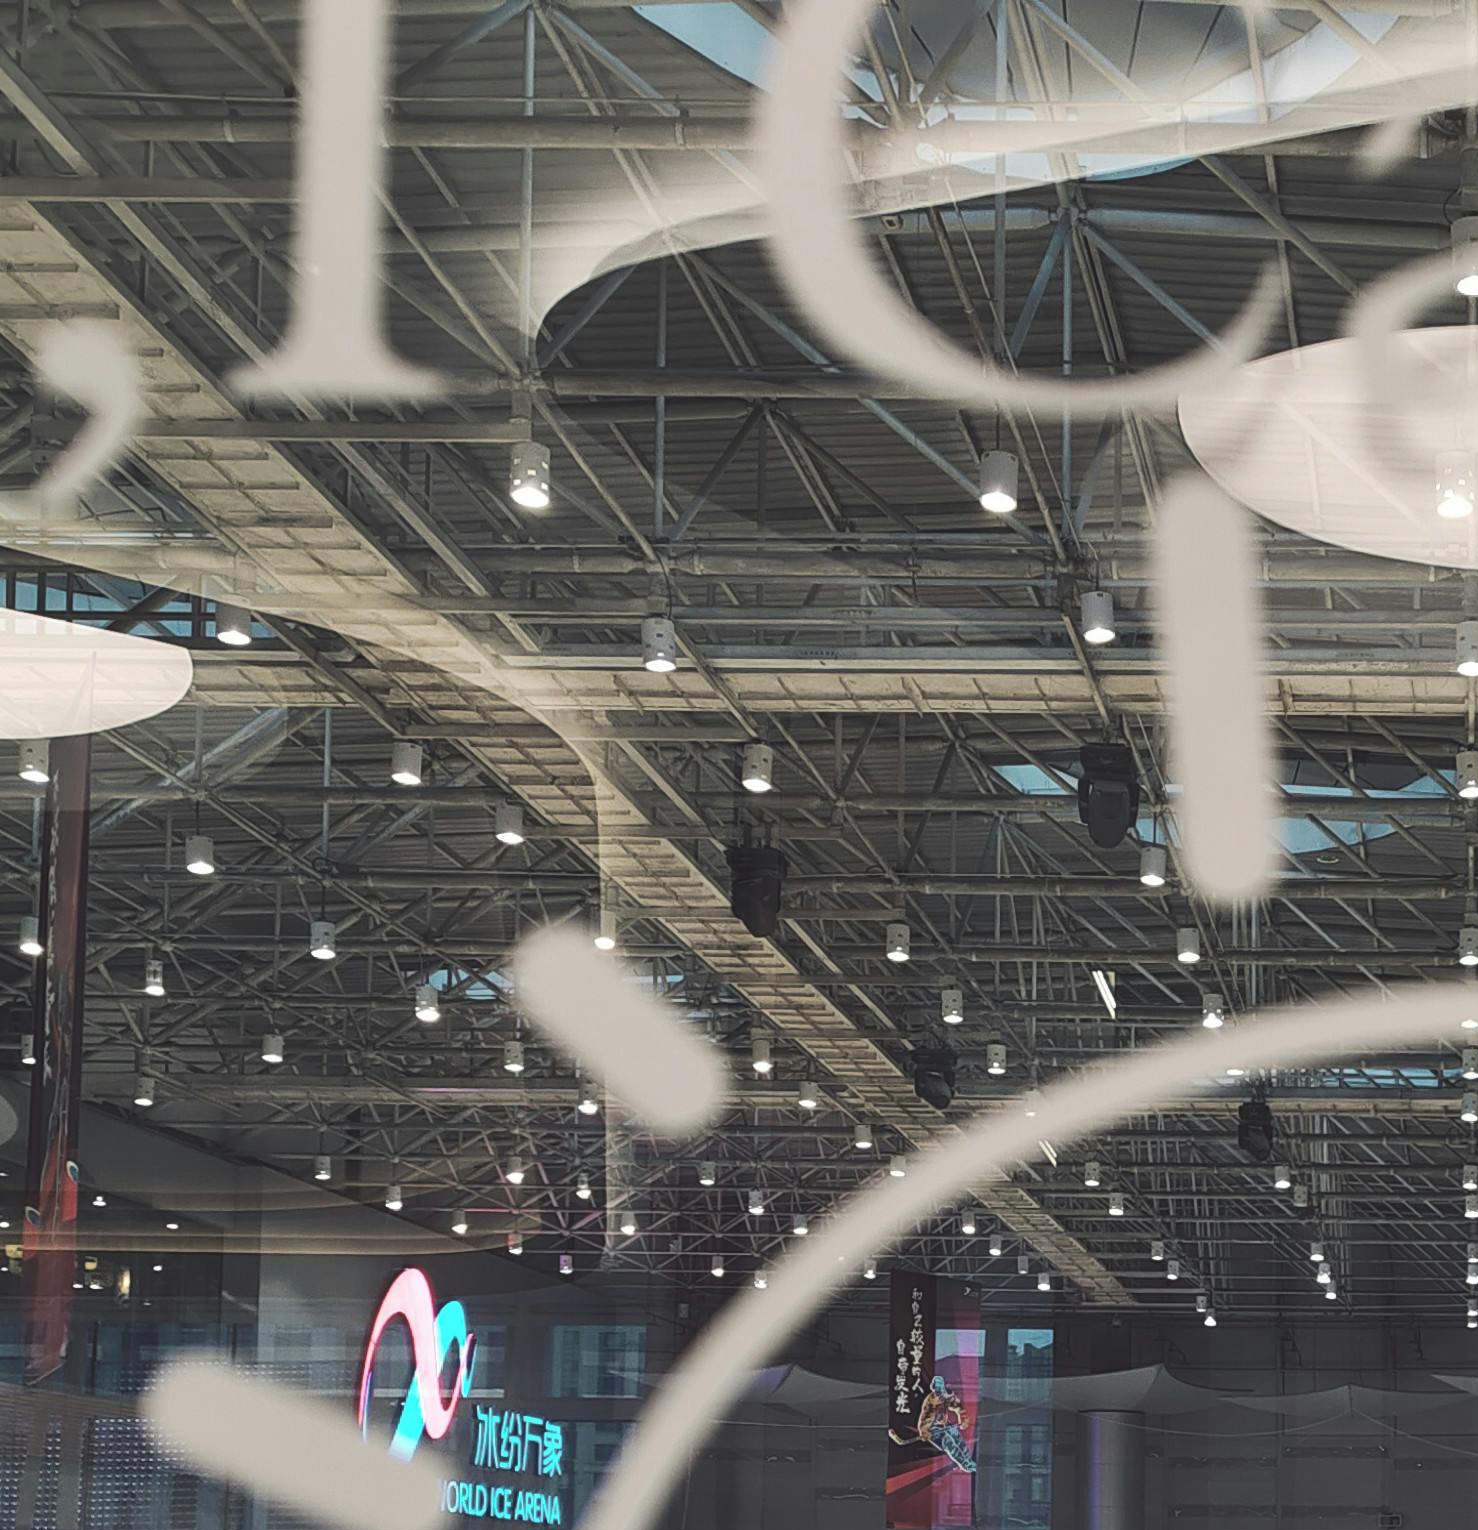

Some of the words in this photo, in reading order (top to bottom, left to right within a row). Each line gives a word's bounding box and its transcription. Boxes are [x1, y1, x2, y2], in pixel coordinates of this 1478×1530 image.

[474, 1404, 563, 1478] 冰纷万象
[440, 1480, 488, 1517] ORLD
[490, 1487, 512, 1520] ICE
[514, 1490, 561, 1526] ARENA
